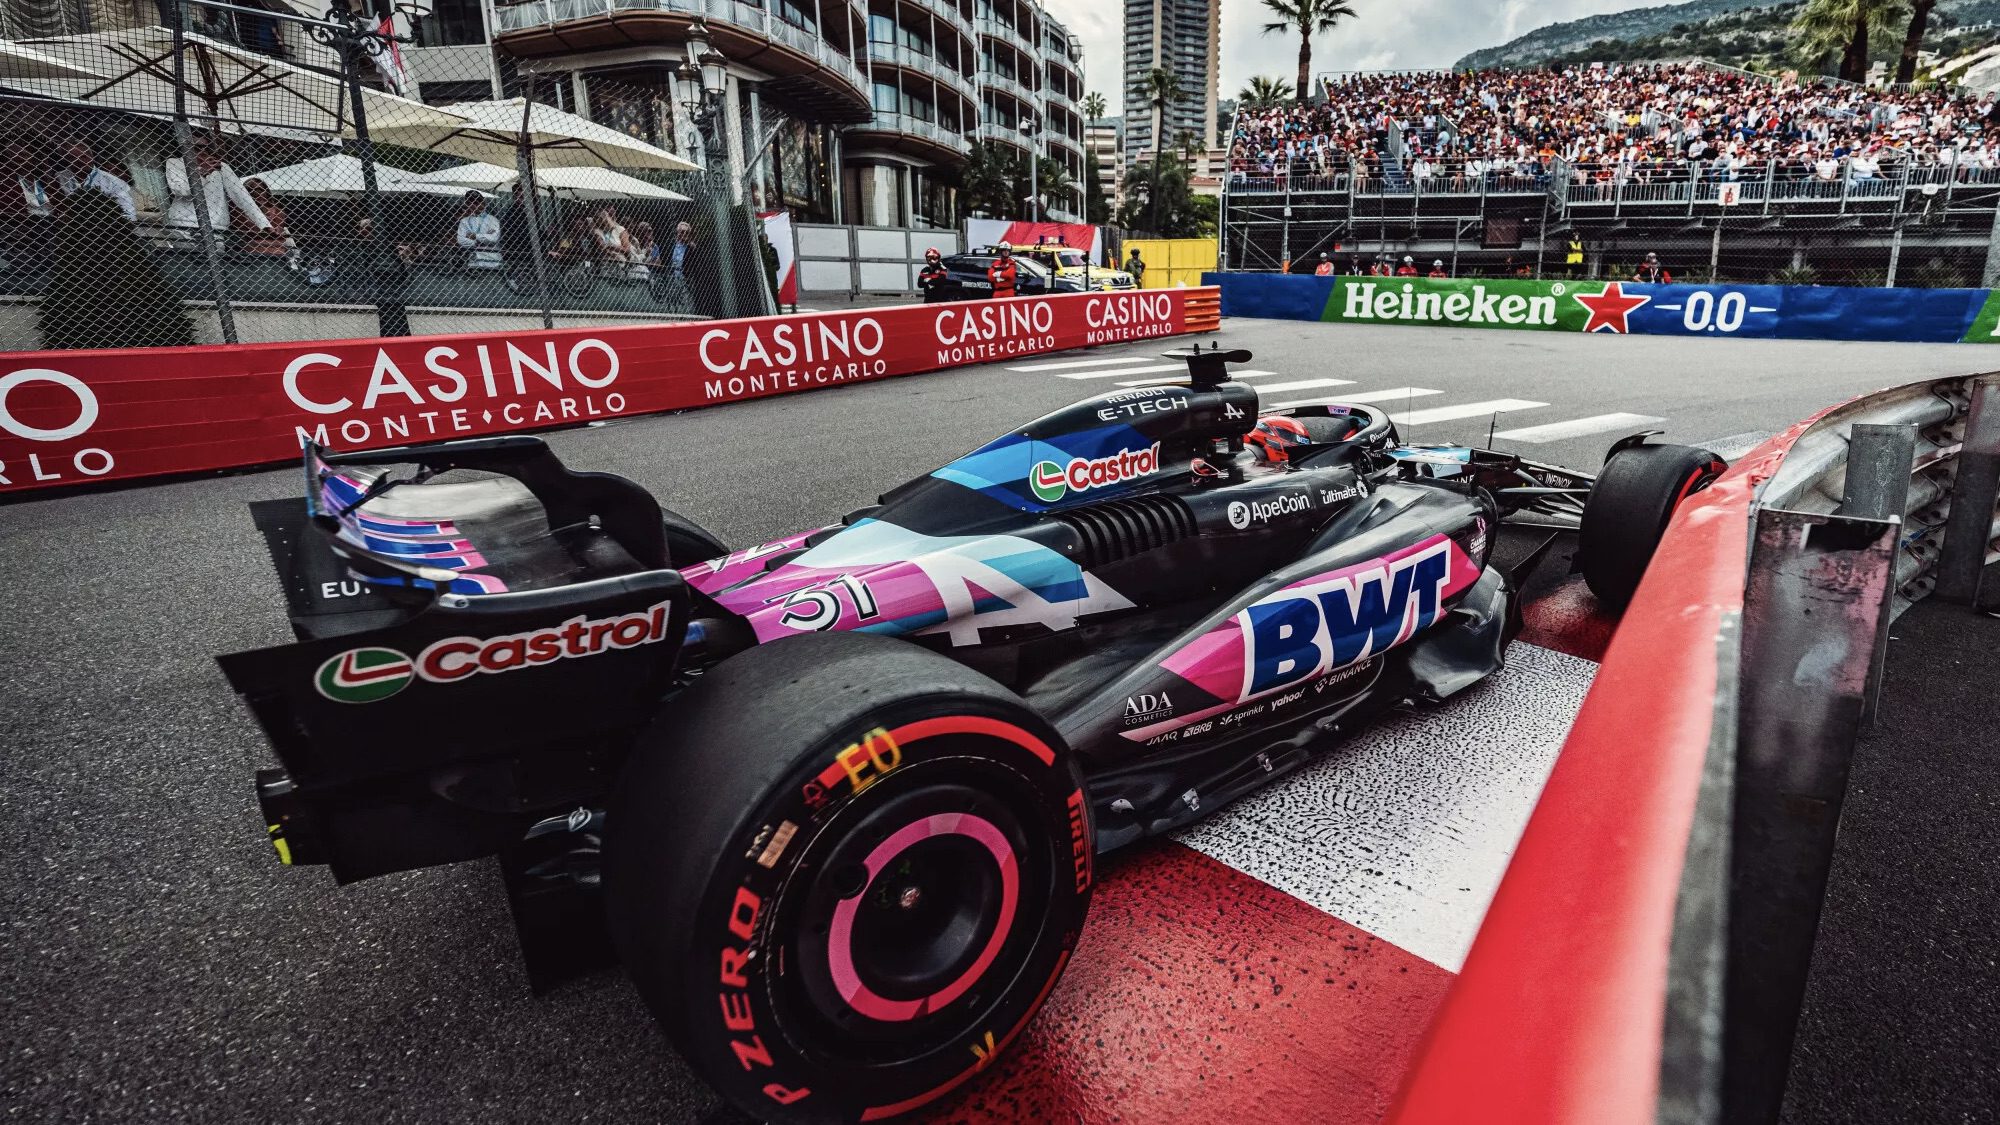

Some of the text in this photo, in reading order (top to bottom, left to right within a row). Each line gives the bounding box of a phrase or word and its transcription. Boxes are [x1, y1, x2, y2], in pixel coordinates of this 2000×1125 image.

[935, 301, 1053, 345] CASINO
[1086, 293, 1172, 328] CASINO
[1683, 290, 1746, 332] 0.0
[699, 317, 884, 374] CASINO
[937, 335, 1055, 365] MONTE CARLO
[1087, 322, 1172, 344] MONTE CARLO
[282, 338, 620, 415] CASINO
[705, 359, 887, 399] MONTE CARLO
[1107, 388, 1166, 404] RENAULT
[295, 392, 626, 450] MONTE CARLO
[1067, 443, 1160, 491] Castrol
[1545, 472, 1573, 489] INFINOX
[1252, 492, 1310, 524] ApeCoin
[1322, 485, 1357, 505] ultimate
[321, 581, 371, 599] EU
[763, 573, 881, 632] 31
[1247, 548, 1448, 697] BWT
[420, 603, 669, 681] Castrol
[1329, 658, 1372, 686] BINANCE
[1124, 691, 1174, 716] ADA
[1125, 710, 1174, 726] COSMETICS
[1234, 704, 1265, 722] sprinklr
[1066, 787, 1092, 895] PIRELLI
[719, 886, 775, 1072] ZERO
[763, 1083, 812, 1105] P
